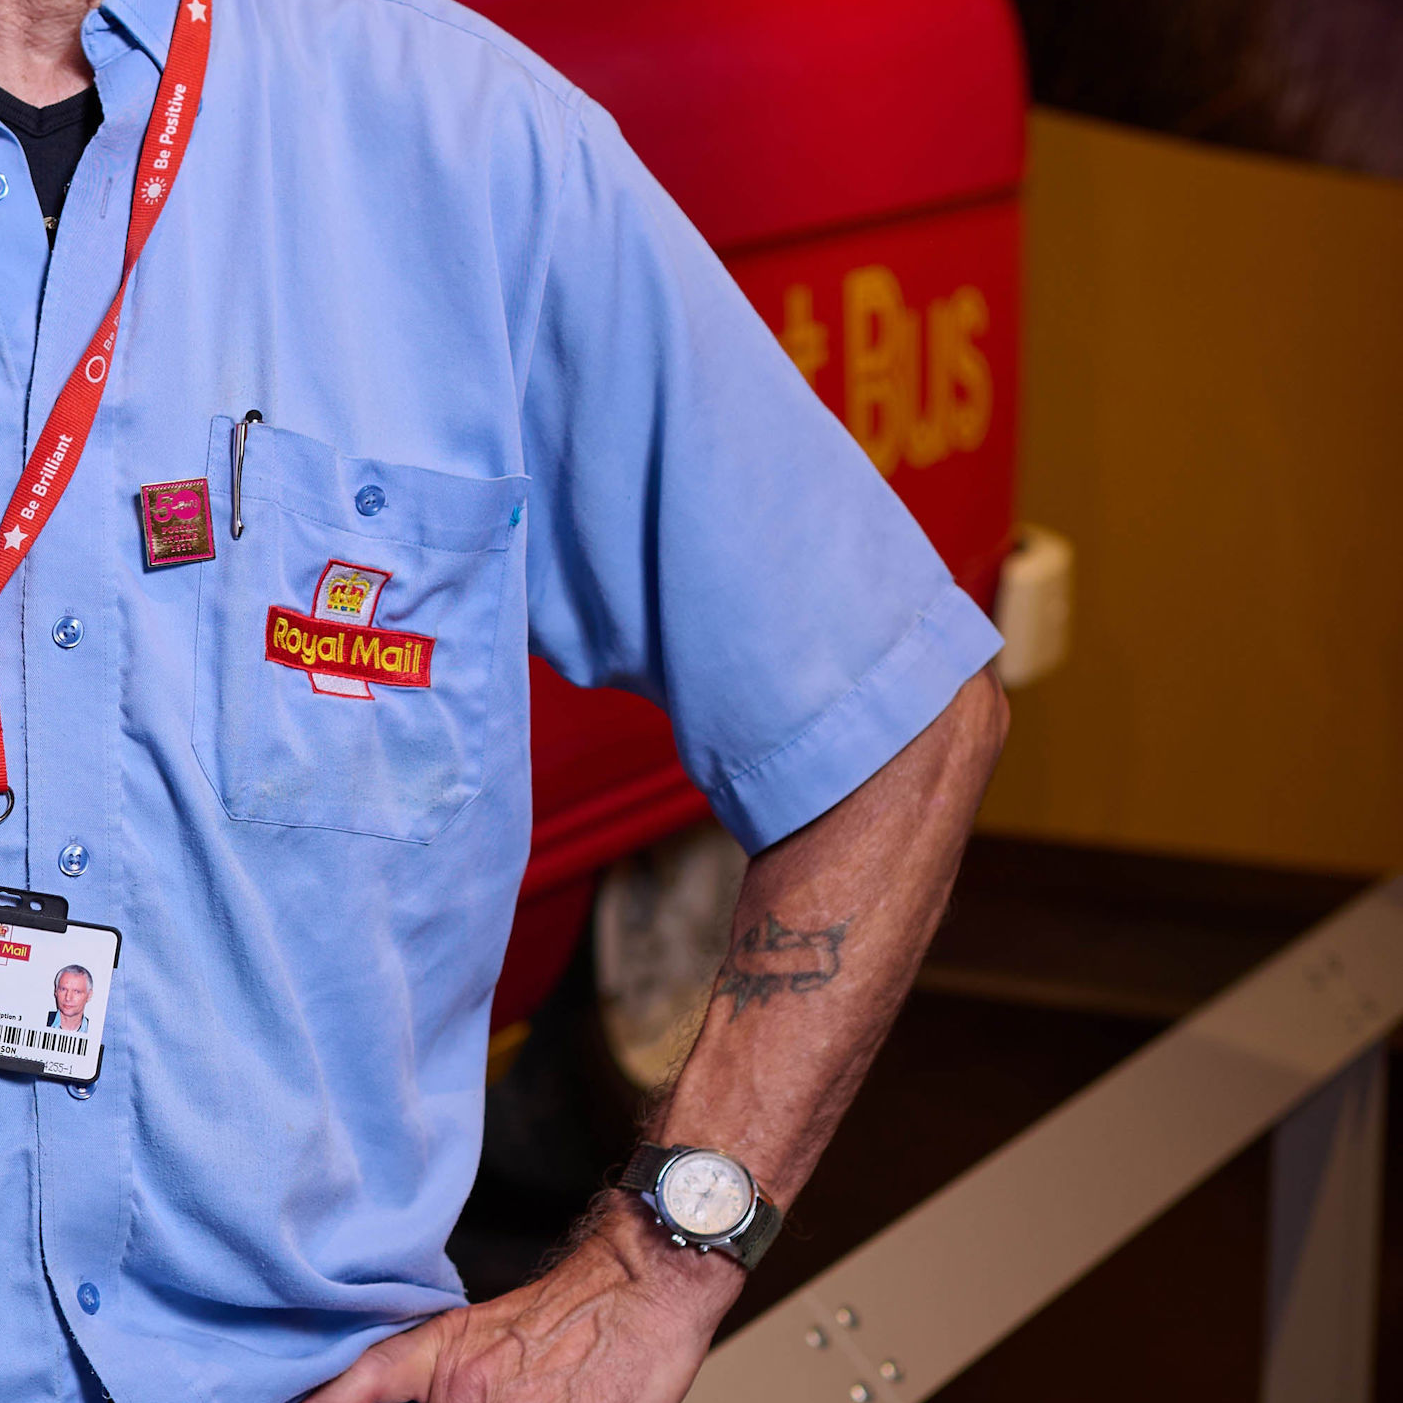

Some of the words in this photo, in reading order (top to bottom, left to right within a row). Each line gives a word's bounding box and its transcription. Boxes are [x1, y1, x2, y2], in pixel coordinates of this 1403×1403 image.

[158, 83, 187, 145] Positive
[153, 149, 171, 169] Be
[103, 332, 115, 351] Be
[20, 500, 40, 520] Be
[31, 434, 73, 497] Brilliant
[273, 617, 345, 665] Royal
[350, 635, 423, 674] Mail
[2, 943, 28, 957] Mail
